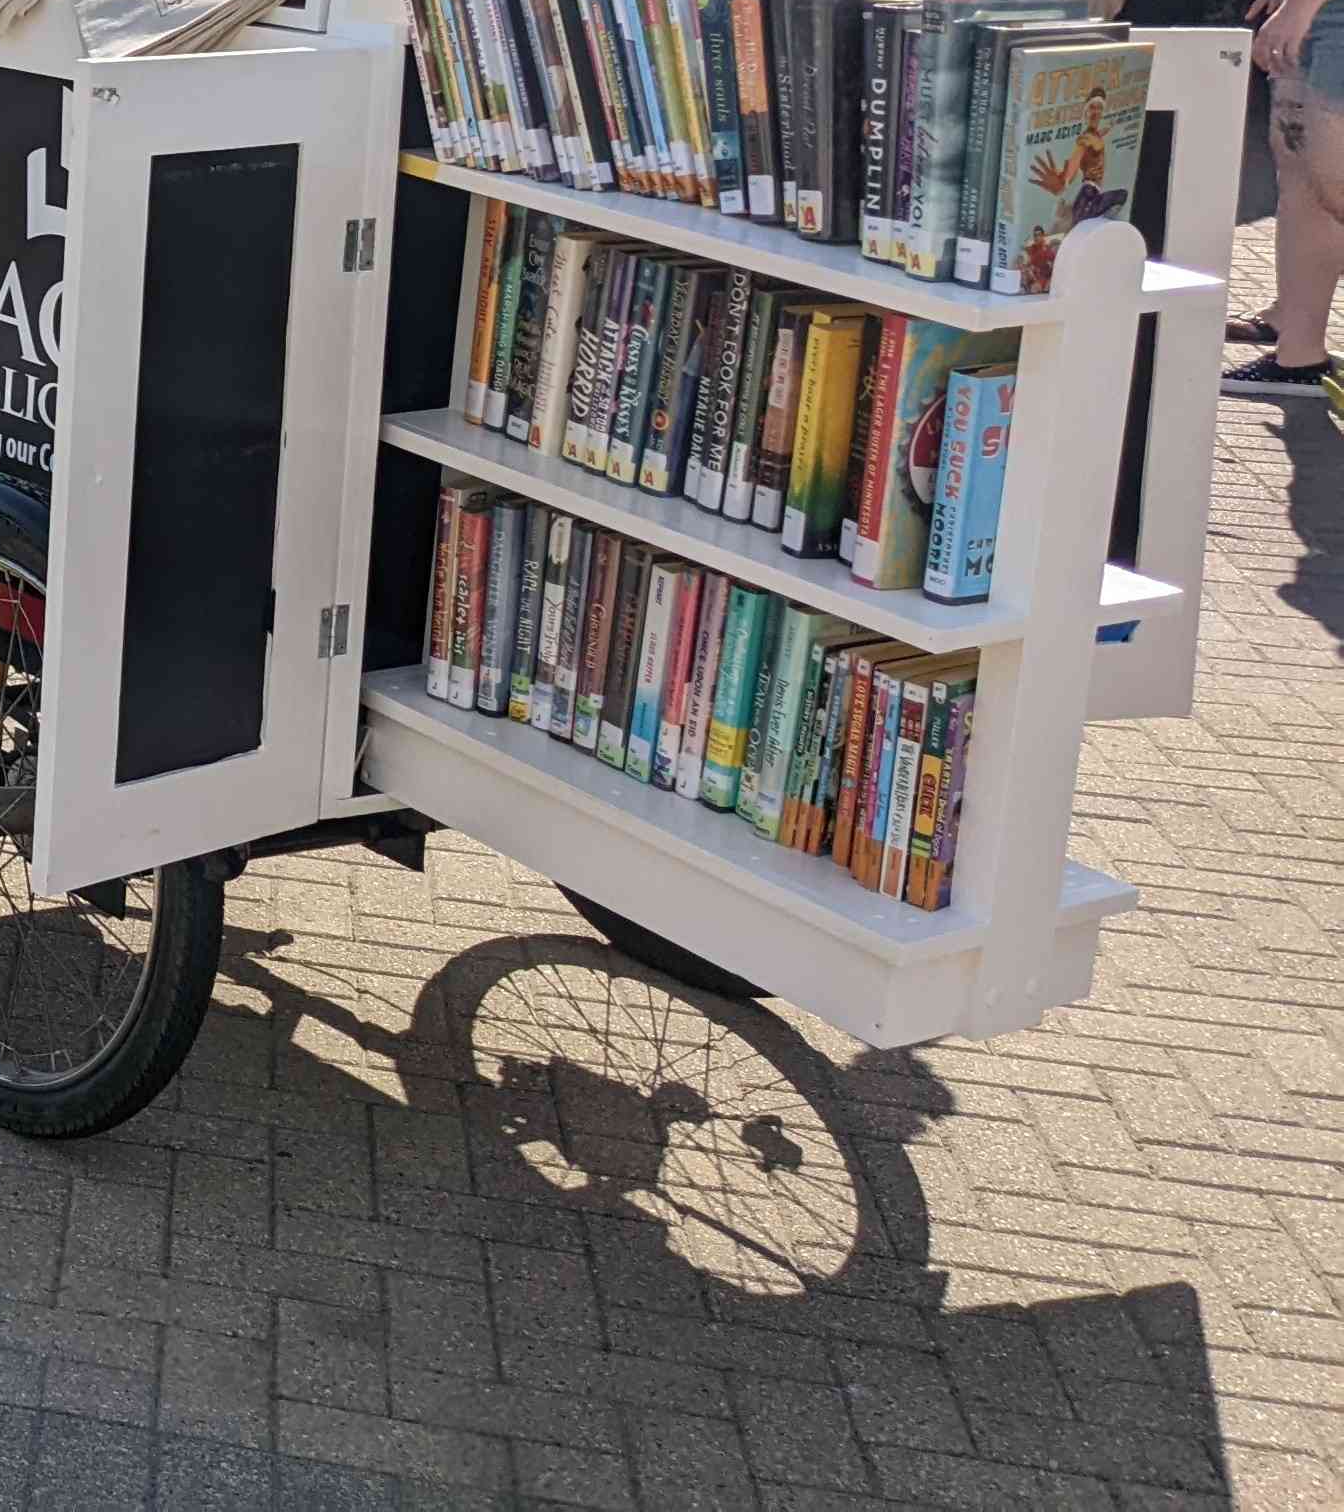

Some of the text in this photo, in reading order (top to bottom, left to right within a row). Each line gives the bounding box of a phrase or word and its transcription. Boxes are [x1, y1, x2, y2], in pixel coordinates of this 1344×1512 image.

[865, 78, 887, 210] DUMPLIN
[726, 273, 747, 334] DON'T
[597, 317, 620, 384] ATTACK
[571, 328, 599, 417] HORRID
[694, 376, 710, 436] NATALIE
[711, 399, 729, 437] FOR
[872, 395, 887, 427] LAGER
[6, 437, 37, 469] our
[708, 443, 723, 471] ME
[869, 429, 881, 462] QUEEN
[944, 386, 973, 501] YOU SUCK
[860, 479, 875, 536] MINNESOTA
[928, 502, 947, 571] MOORE
[516, 616, 533, 654] NIGHT
[698, 630, 709, 663] ONCE
[693, 665, 705, 696] UPON
[774, 678, 790, 709] Denis
[770, 710, 788, 734] Ever
[846, 680, 867, 777] LOVE SUGAR MAGIC
